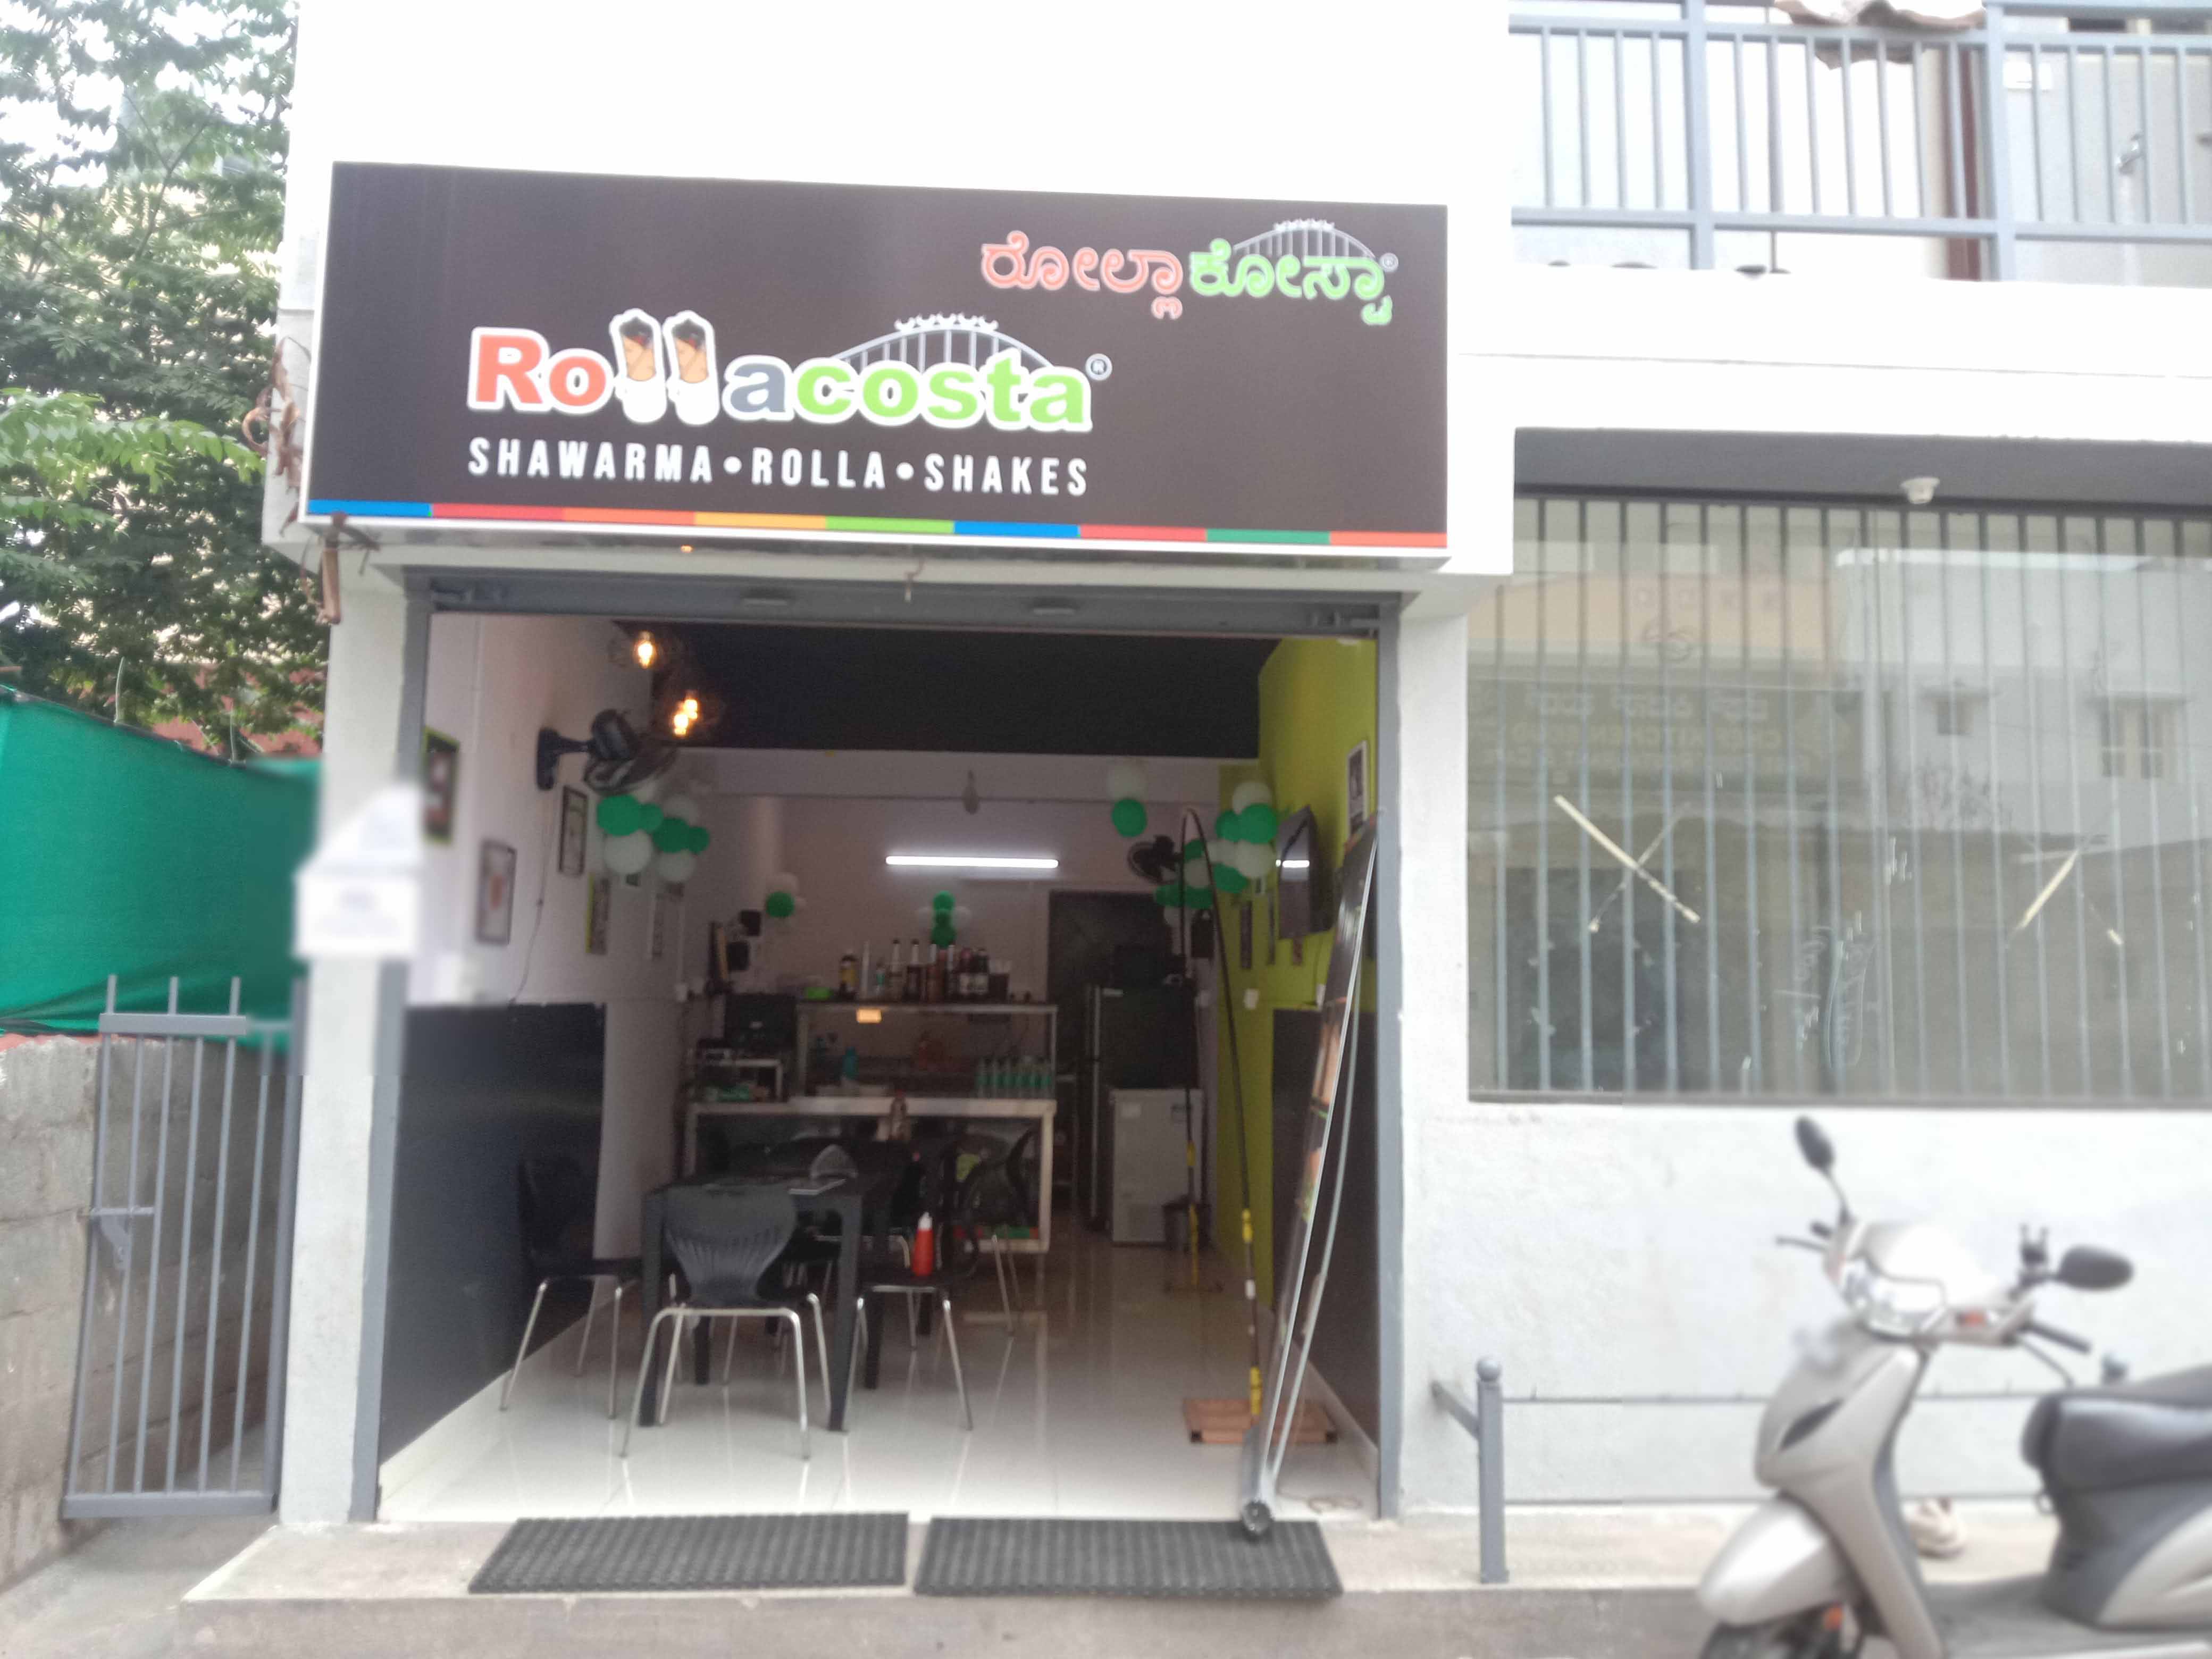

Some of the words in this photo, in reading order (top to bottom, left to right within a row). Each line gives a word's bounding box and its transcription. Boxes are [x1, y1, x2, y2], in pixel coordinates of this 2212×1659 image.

[467, 437, 714, 484] SHAWARMA
[751, 447, 886, 489] ROLLA
[924, 453, 1088, 496] SHAKES
